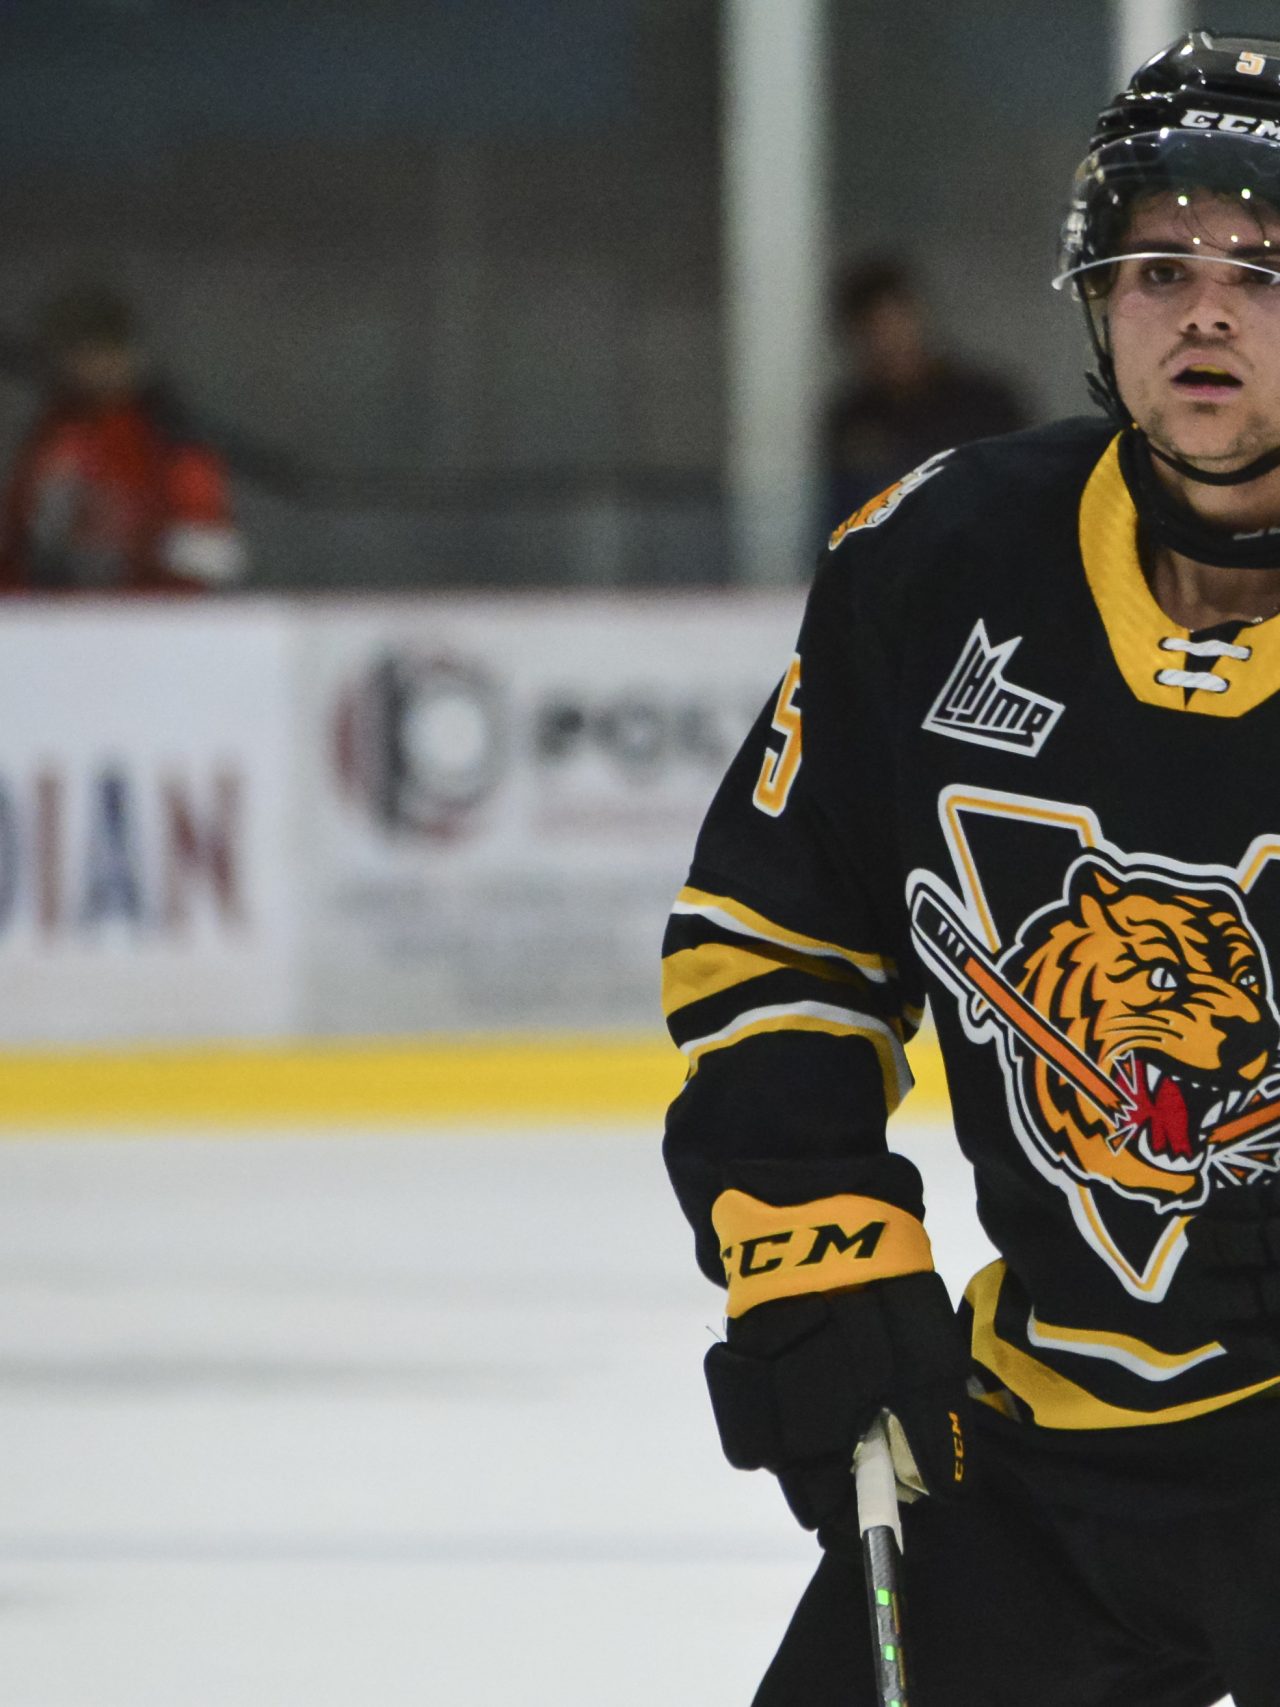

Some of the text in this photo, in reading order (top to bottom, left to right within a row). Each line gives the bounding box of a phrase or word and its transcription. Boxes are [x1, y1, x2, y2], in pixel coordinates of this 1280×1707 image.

[1235, 51, 1266, 75] 5
[532, 692, 766, 782] POL
[752, 652, 802, 818] 5
[722, 1221, 888, 1287] CM
[948, 1410, 964, 1482] CCM
